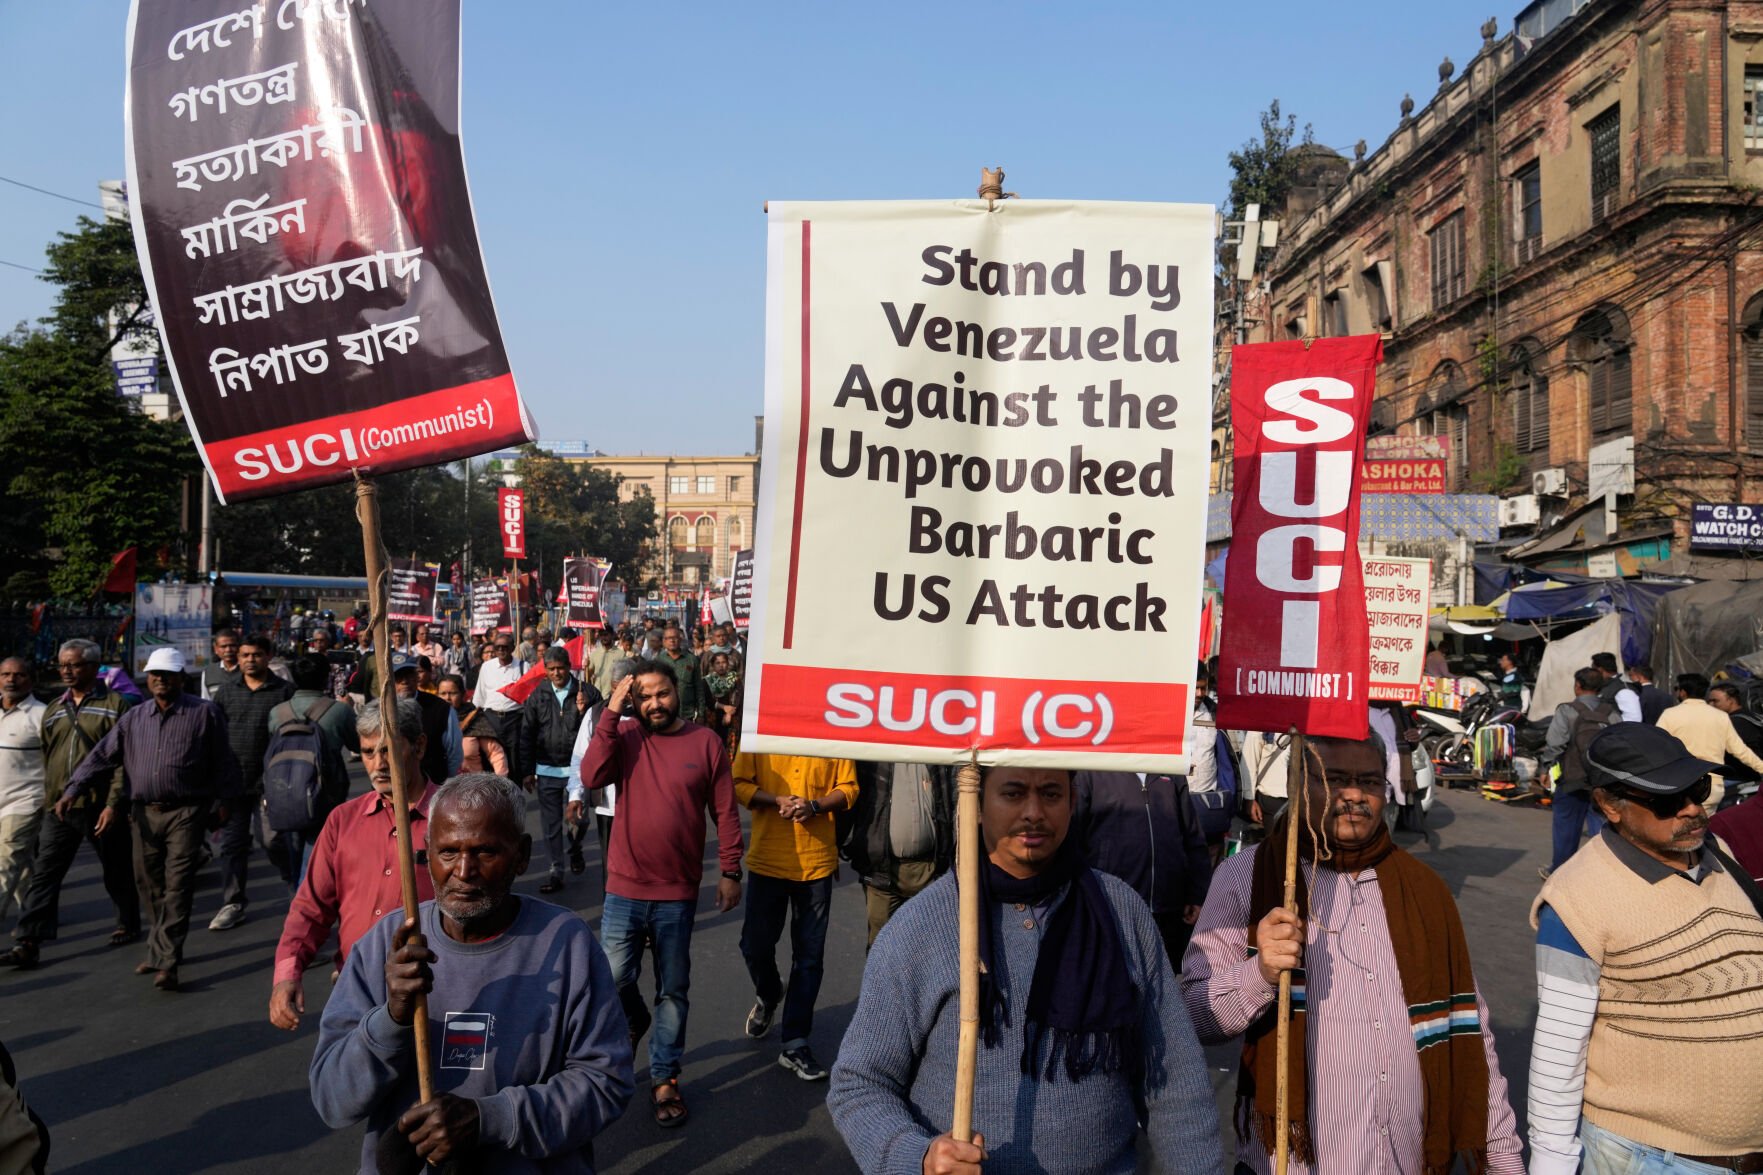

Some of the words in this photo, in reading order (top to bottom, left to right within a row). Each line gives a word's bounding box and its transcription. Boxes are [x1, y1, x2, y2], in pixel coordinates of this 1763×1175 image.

[168, 4, 265, 61] দেশে
[168, 61, 299, 123] গণতন্ত্র
[172, 106, 367, 192] হত্যাকারী
[181, 193, 309, 260] মার্কিন
[193, 247, 424, 327] সাম্রাজ্যবাদ
[921, 244, 1088, 298] Stand
[1108, 249, 1181, 312] by
[209, 339, 329, 399] নিপাত
[337, 315, 421, 366] যাক
[880, 301, 1181, 364] Venezuela
[833, 363, 1058, 430] Against
[1077, 379, 1179, 430] the
[234, 428, 359, 481] SUCI
[360, 398, 495, 458] (Communist)
[819, 427, 1176, 499] Unprovoked
[1400, 480, 1412, 490] Bar
[504, 494, 521, 548] SUCI
[908, 505, 1156, 565] Barbaric
[1255, 376, 1355, 669] SUCI
[1695, 521, 1748, 536] WATCH
[873, 572, 951, 624] US
[965, 579, 1168, 633] Attack
[1370, 635, 1414, 652] ক্রমণকে
[824, 682, 996, 737] SUCI
[1020, 690, 1114, 746] (C)
